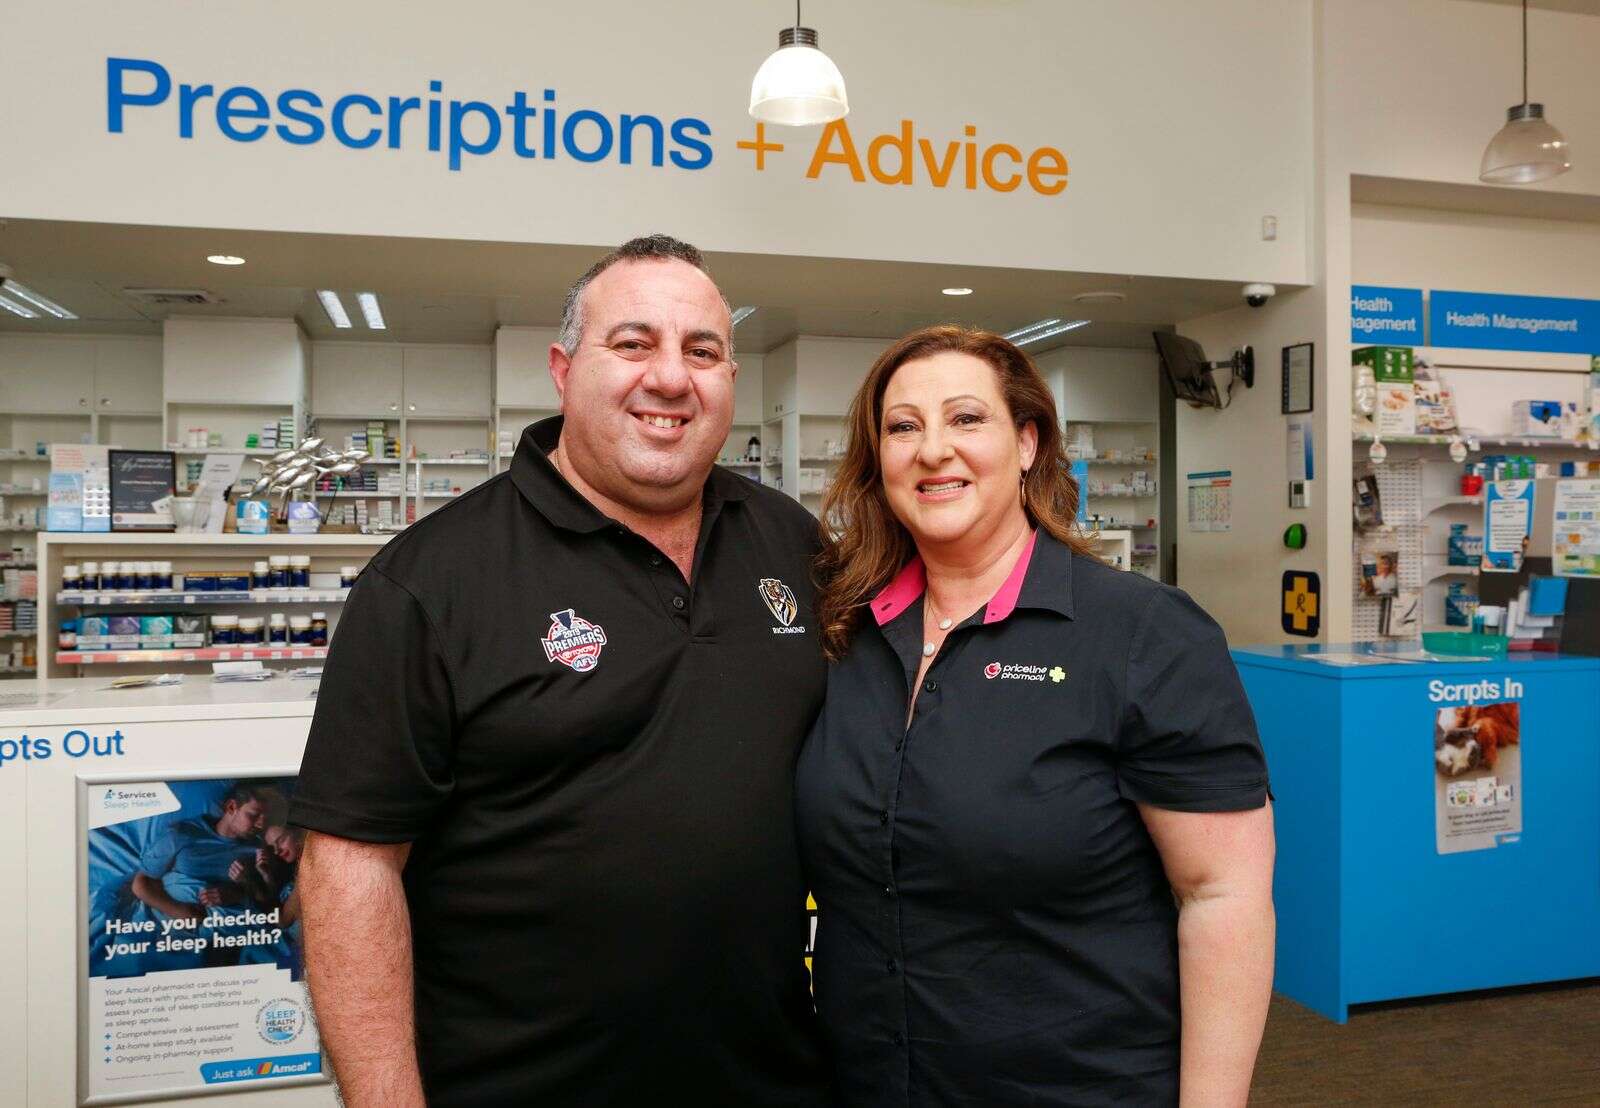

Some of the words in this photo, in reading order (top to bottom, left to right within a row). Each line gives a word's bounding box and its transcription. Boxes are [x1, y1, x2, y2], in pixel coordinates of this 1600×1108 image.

[107, 57, 713, 171] Prescriptions
[806, 118, 1068, 195] Advice
[1446, 311, 1490, 327] Health
[1492, 313, 1578, 333] Management
[772, 626, 805, 634] RICHMOND
[545, 627, 604, 657] PREMIERS
[1003, 664, 1047, 674] priceline
[1001, 672, 1046, 681] pharmacy
[1428, 680, 1500, 705] Scripts
[1504, 677, 1523, 698] In
[63, 730, 124, 758] Out
[118, 791, 157, 799] Services
[104, 801, 128, 809] Sleep
[105, 919, 154, 935] Have
[161, 917, 197, 935] you
[203, 908, 279, 928] checked
[105, 942, 150, 960] your
[156, 936, 207, 953] sleep
[213, 929, 282, 948] health?
[152, 983, 194, 993] pharmacist
[265, 1009, 296, 1019] SLEEP
[265, 1018, 296, 1027] HEALTH
[116, 1029, 178, 1039] Comprehensive
[195, 1022, 240, 1032] assessment
[116, 1053, 152, 1063] Ongoing
[212, 1069, 234, 1080] Just
[236, 1067, 254, 1077] ask
